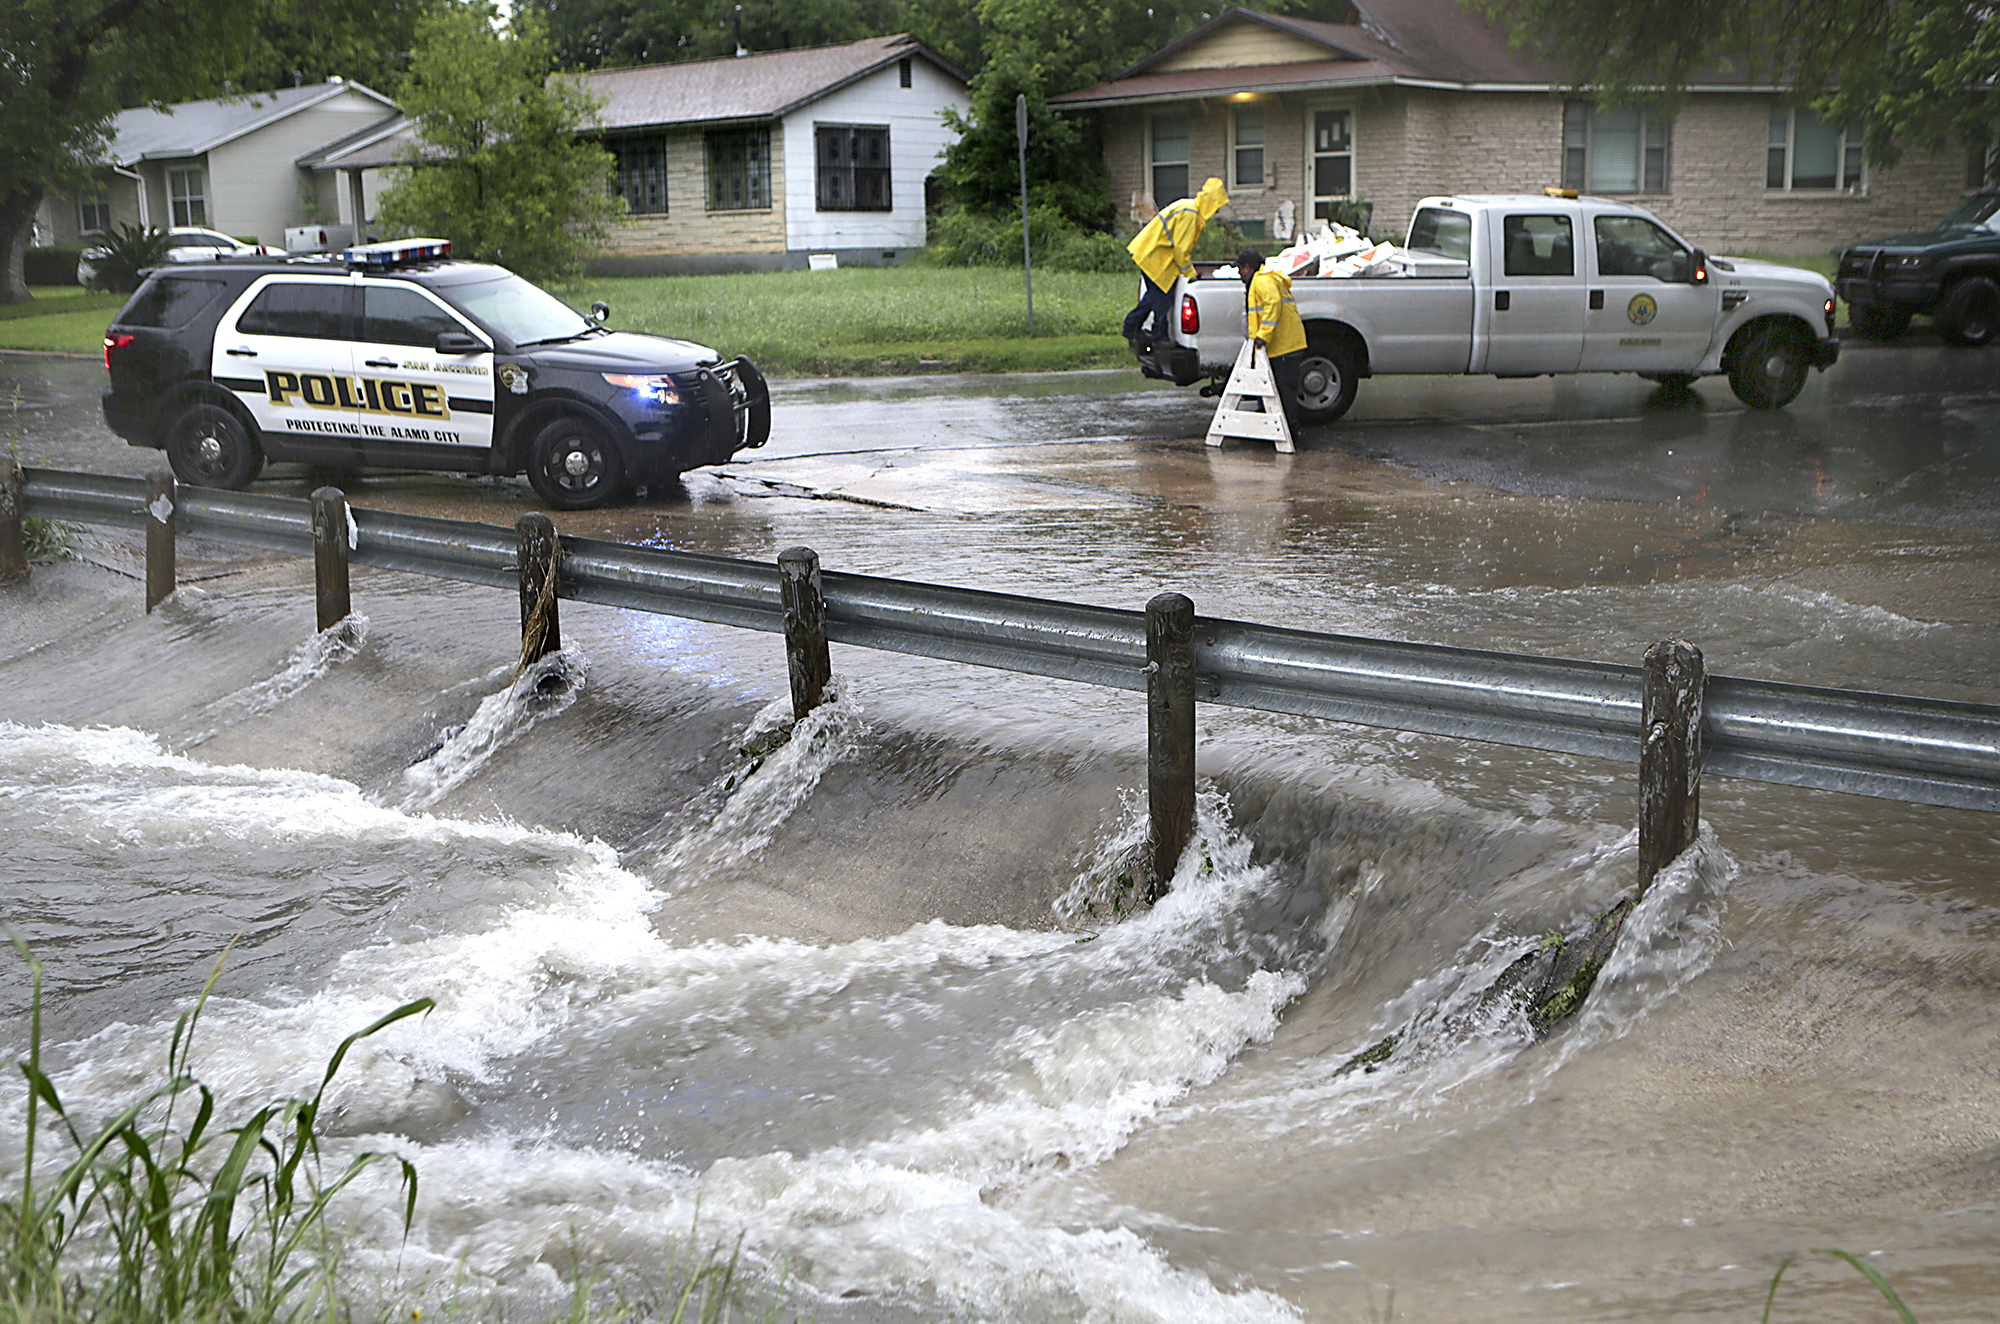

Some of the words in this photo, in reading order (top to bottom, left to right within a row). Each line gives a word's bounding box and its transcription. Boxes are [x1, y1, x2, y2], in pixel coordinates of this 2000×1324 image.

[402, 360, 429, 371] SAN
[433, 362, 488, 375] ANTONIO
[264, 370, 451, 421] POLICE
[285, 418, 359, 435] PROTECTING
[362, 423, 386, 437] THE
[390, 427, 430, 441] ALAMO
[434, 430, 460, 443] CITY
